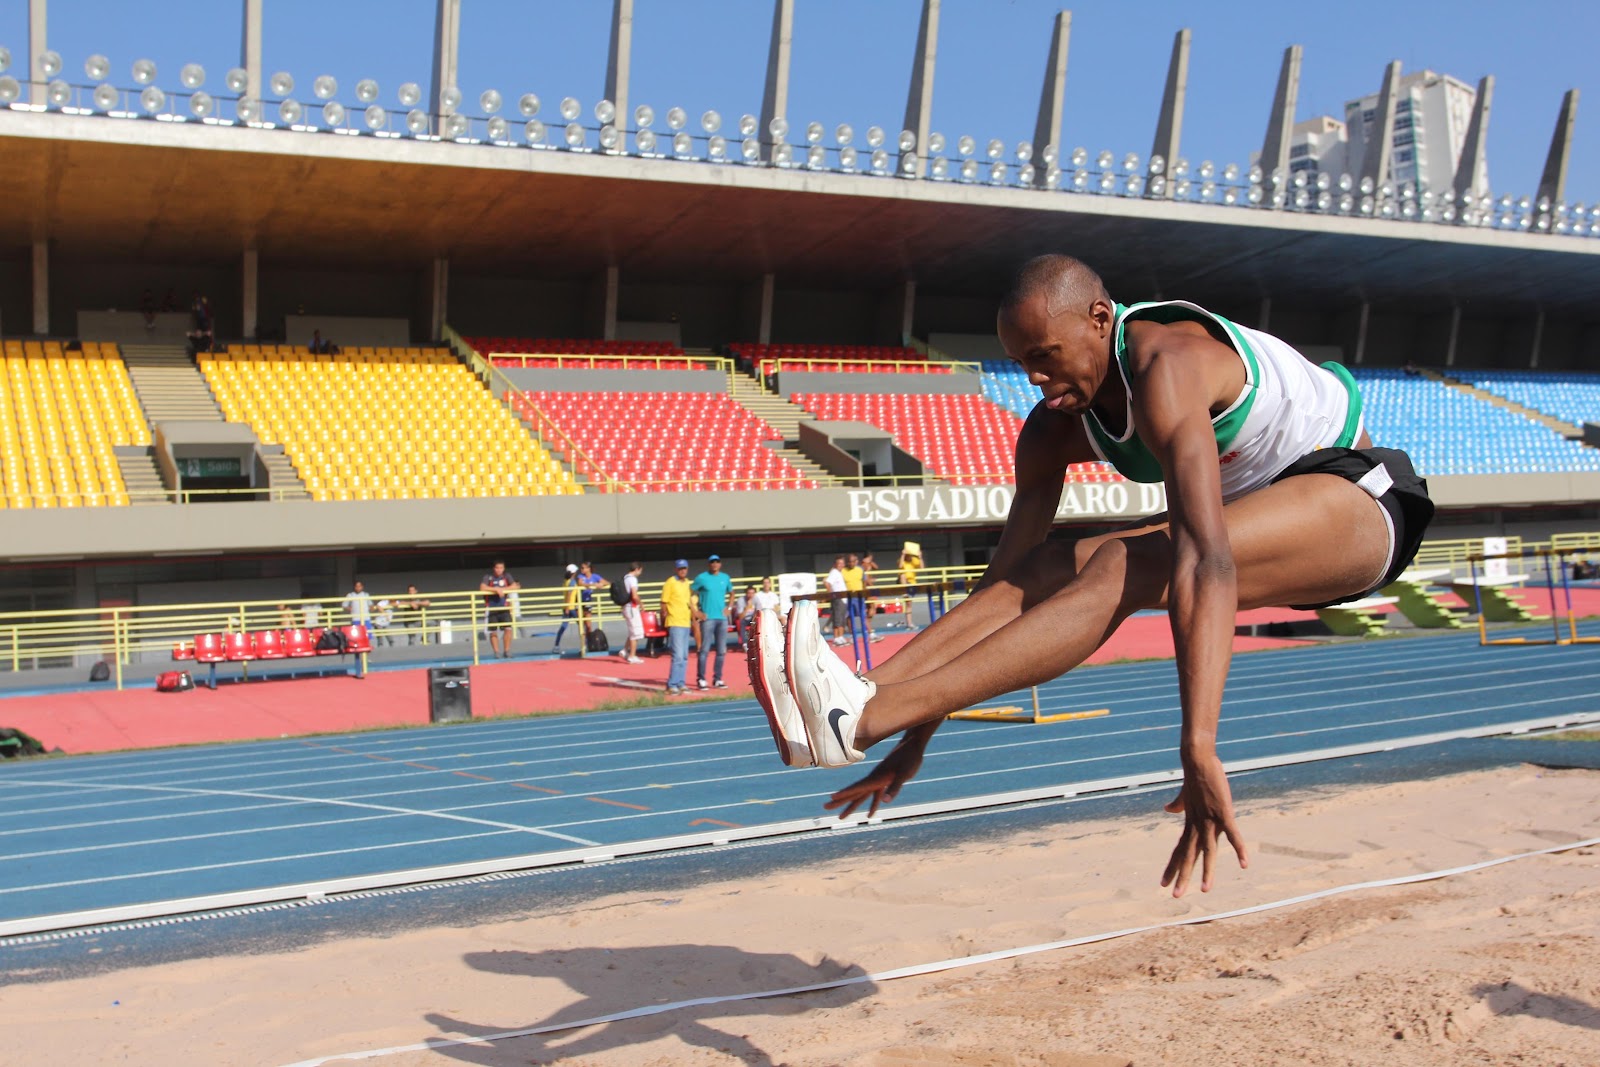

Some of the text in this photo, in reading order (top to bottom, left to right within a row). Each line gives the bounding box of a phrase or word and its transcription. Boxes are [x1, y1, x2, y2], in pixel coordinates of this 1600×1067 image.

[847, 482, 1168, 523] ESTÁDIO ARO D
